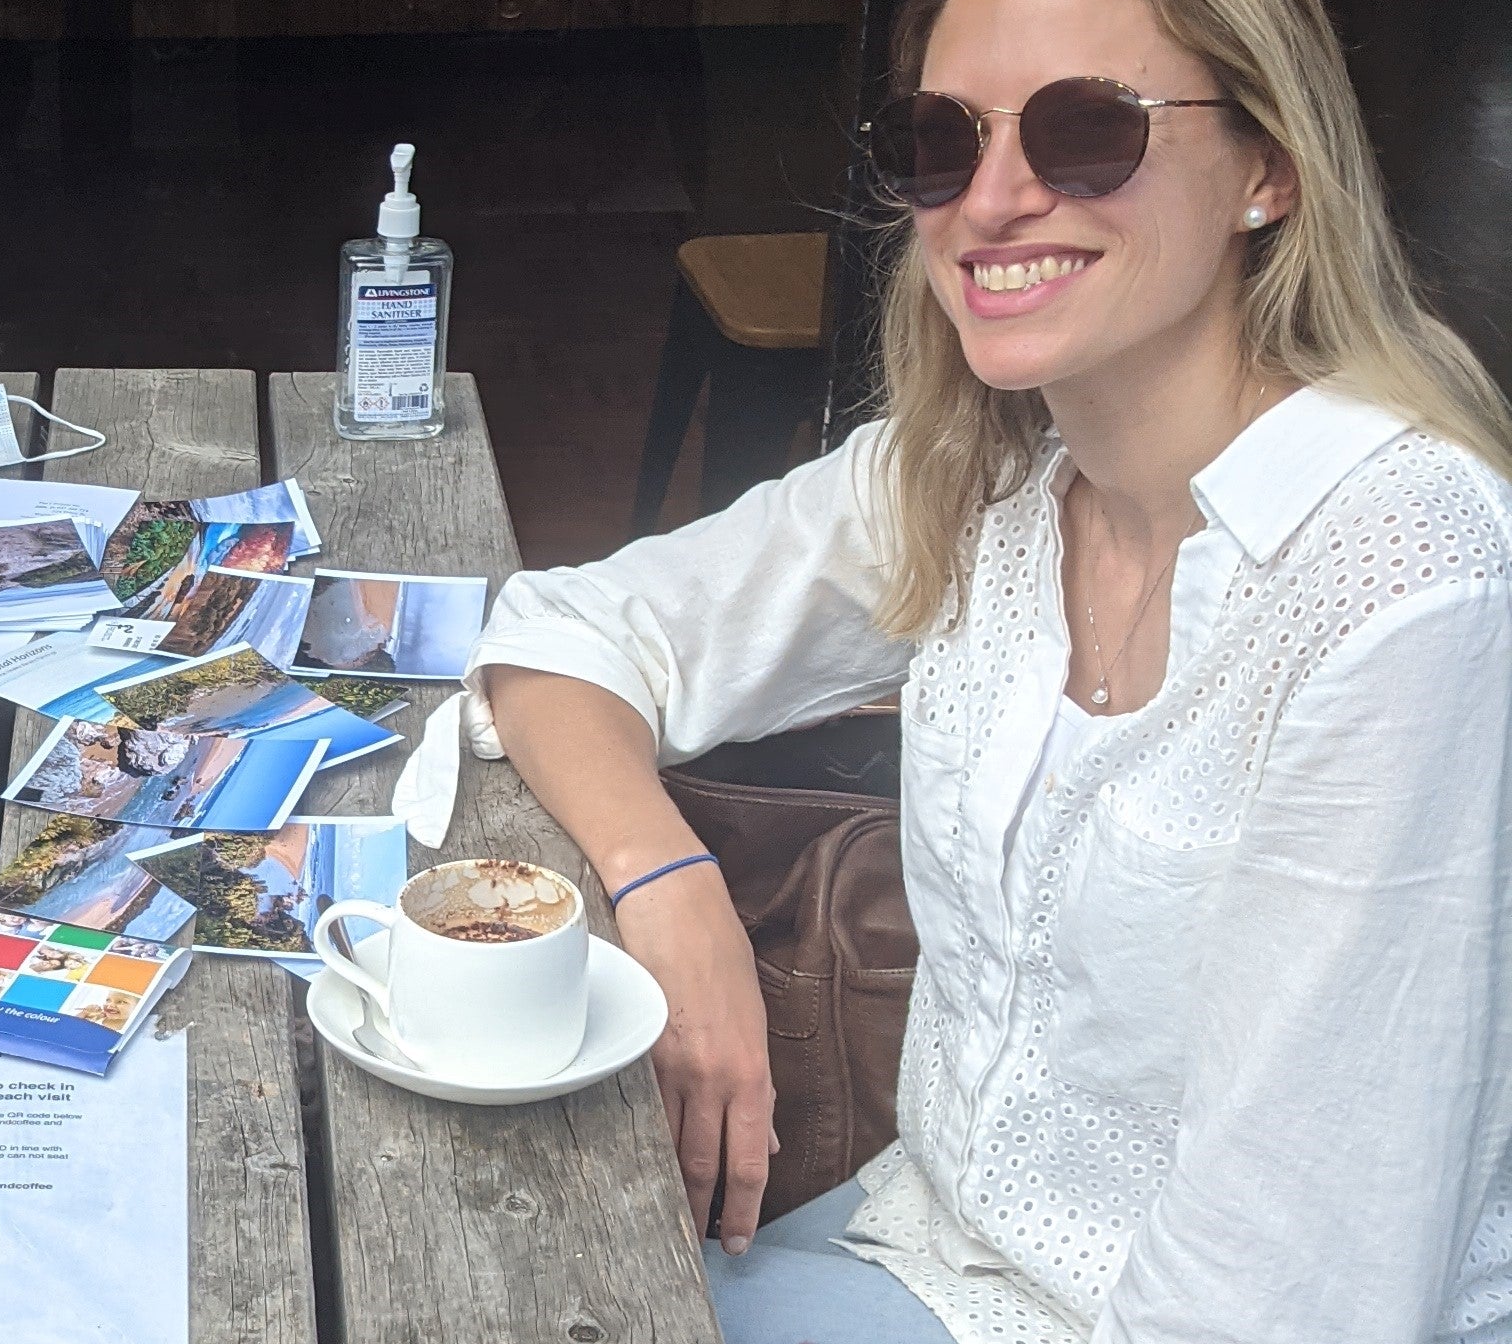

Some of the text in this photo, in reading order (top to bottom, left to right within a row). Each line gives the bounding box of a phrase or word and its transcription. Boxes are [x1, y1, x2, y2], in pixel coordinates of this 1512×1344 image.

[377, 287, 431, 297] LIVINGSTONE
[381, 300, 413, 309] HAND
[371, 309, 422, 319] SANITISER
[10, 644, 53, 663] Horizons
[4, 1007, 25, 1017] the
[24, 1012, 61, 1023] colour
[8, 1081, 56, 1091] check
[60, 1082, 75, 1091] in
[38, 1093, 71, 1101] visit
